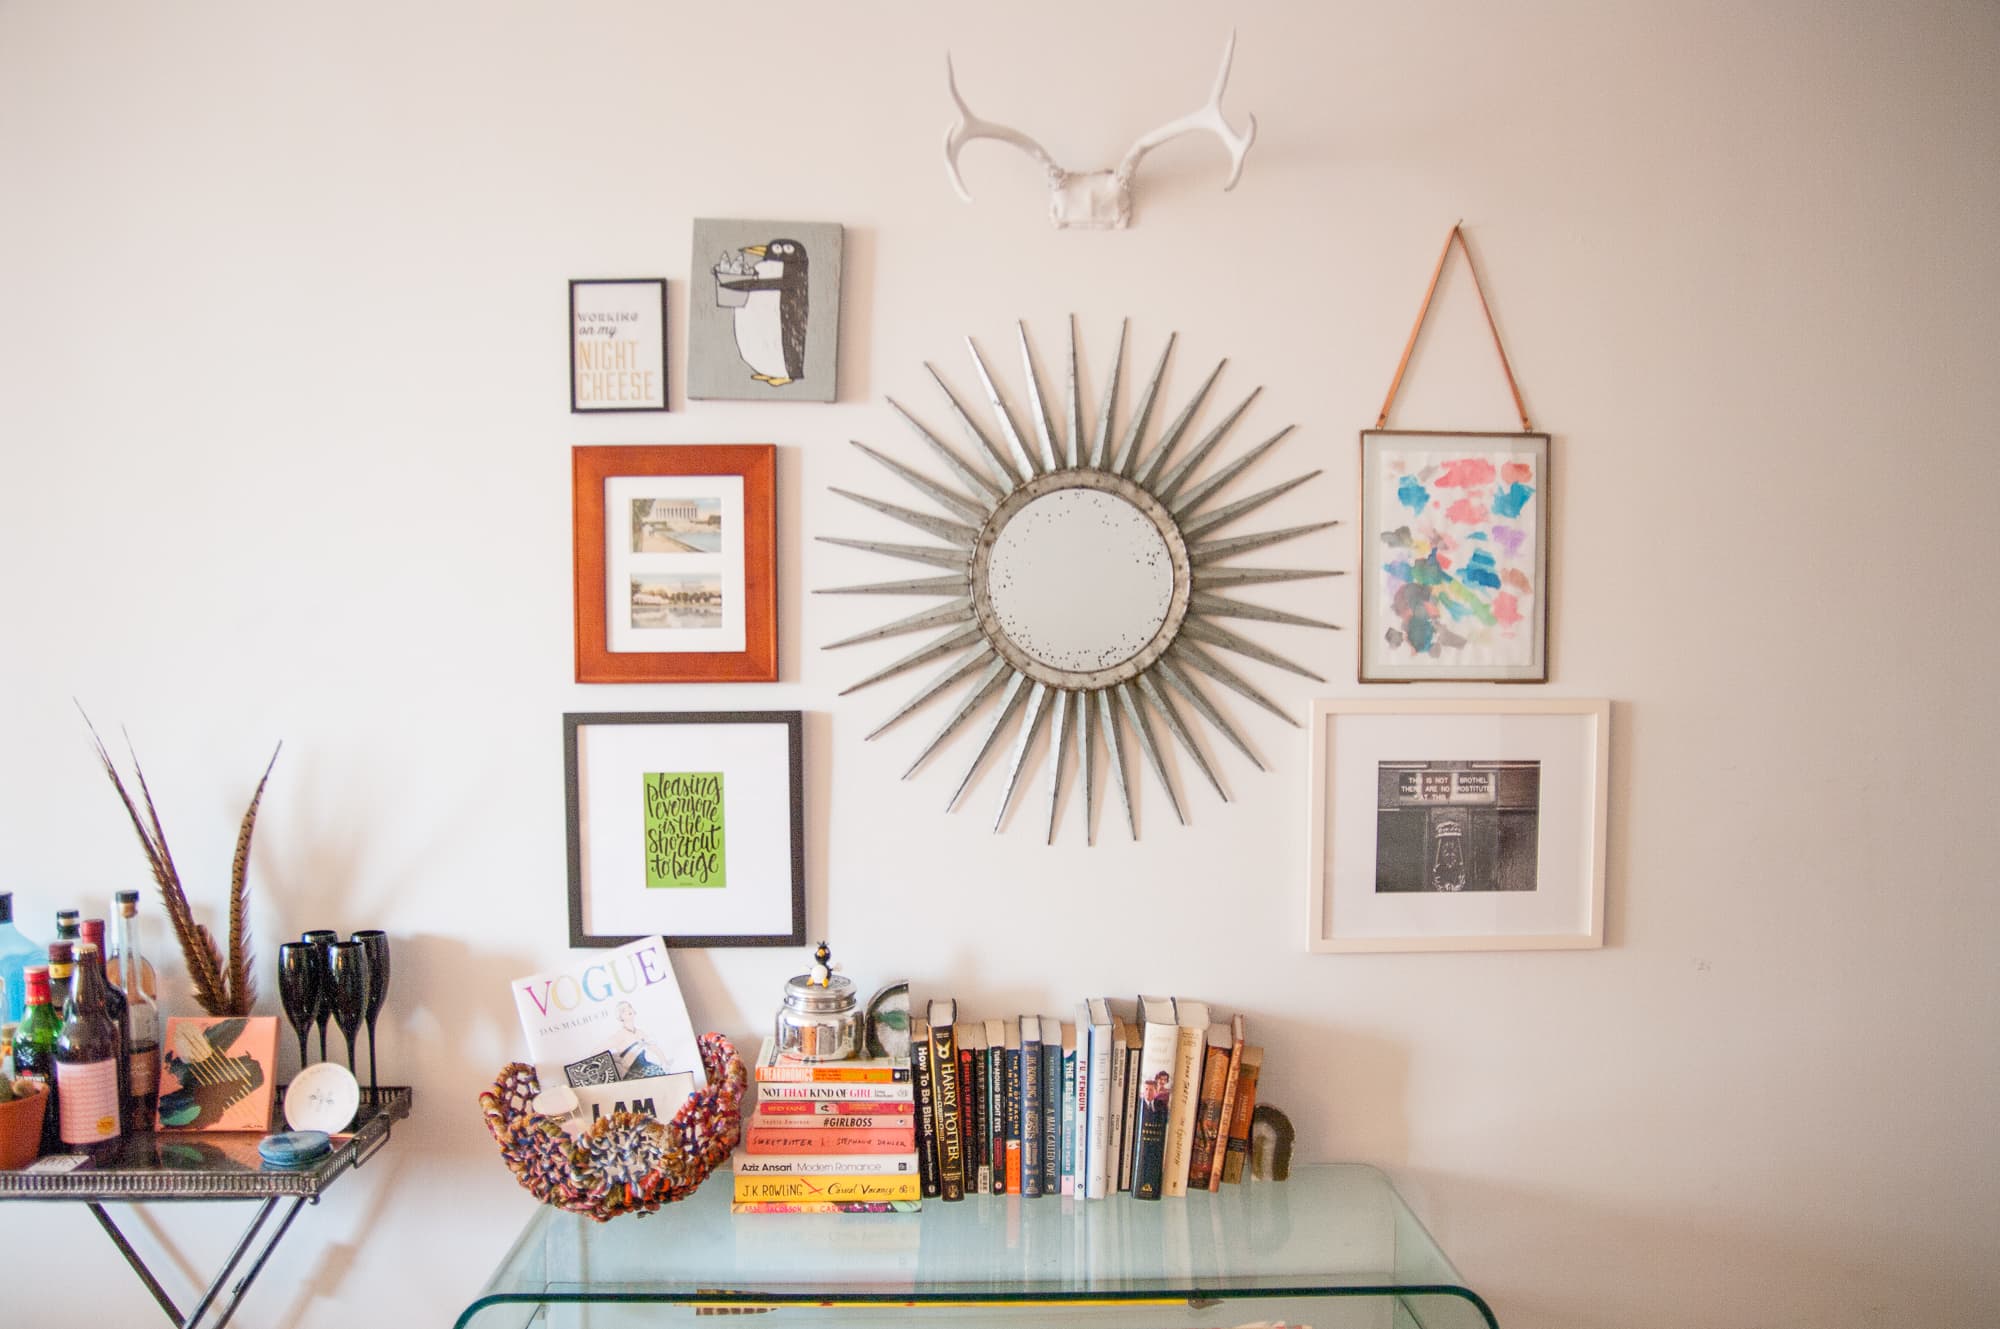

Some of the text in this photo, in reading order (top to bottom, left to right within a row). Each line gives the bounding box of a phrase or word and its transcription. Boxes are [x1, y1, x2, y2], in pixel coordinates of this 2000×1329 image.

[578, 339, 638, 370] NIGHT
[577, 370, 655, 401] CHEESE
[647, 772, 722, 817] pleasing
[655, 796, 721, 822] everyone
[658, 815, 705, 836] is the
[650, 851, 719, 883] to beige
[524, 947, 667, 1016] VOGUE
[918, 1046, 928, 1071] How
[1065, 1062, 1074, 1079] THE
[763, 1088, 780, 1097] NOT
[810, 1088, 834, 1097] KIND
[920, 1073, 930, 1087] To
[941, 1063, 957, 1107] HARRY
[921, 1089, 931, 1103] Be
[823, 1118, 872, 1127] #GIRLBOSS
[922, 1106, 933, 1137] Black
[1047, 1116, 1056, 1133] MAN
[944, 1111, 960, 1162] POTTER
[1047, 1135, 1056, 1160] CALLED
[741, 1163, 882, 1172] Aziz Ansari Modern Romance
[1047, 1162, 1056, 1177] OVE
[762, 1184, 803, 1197] ROWLING
